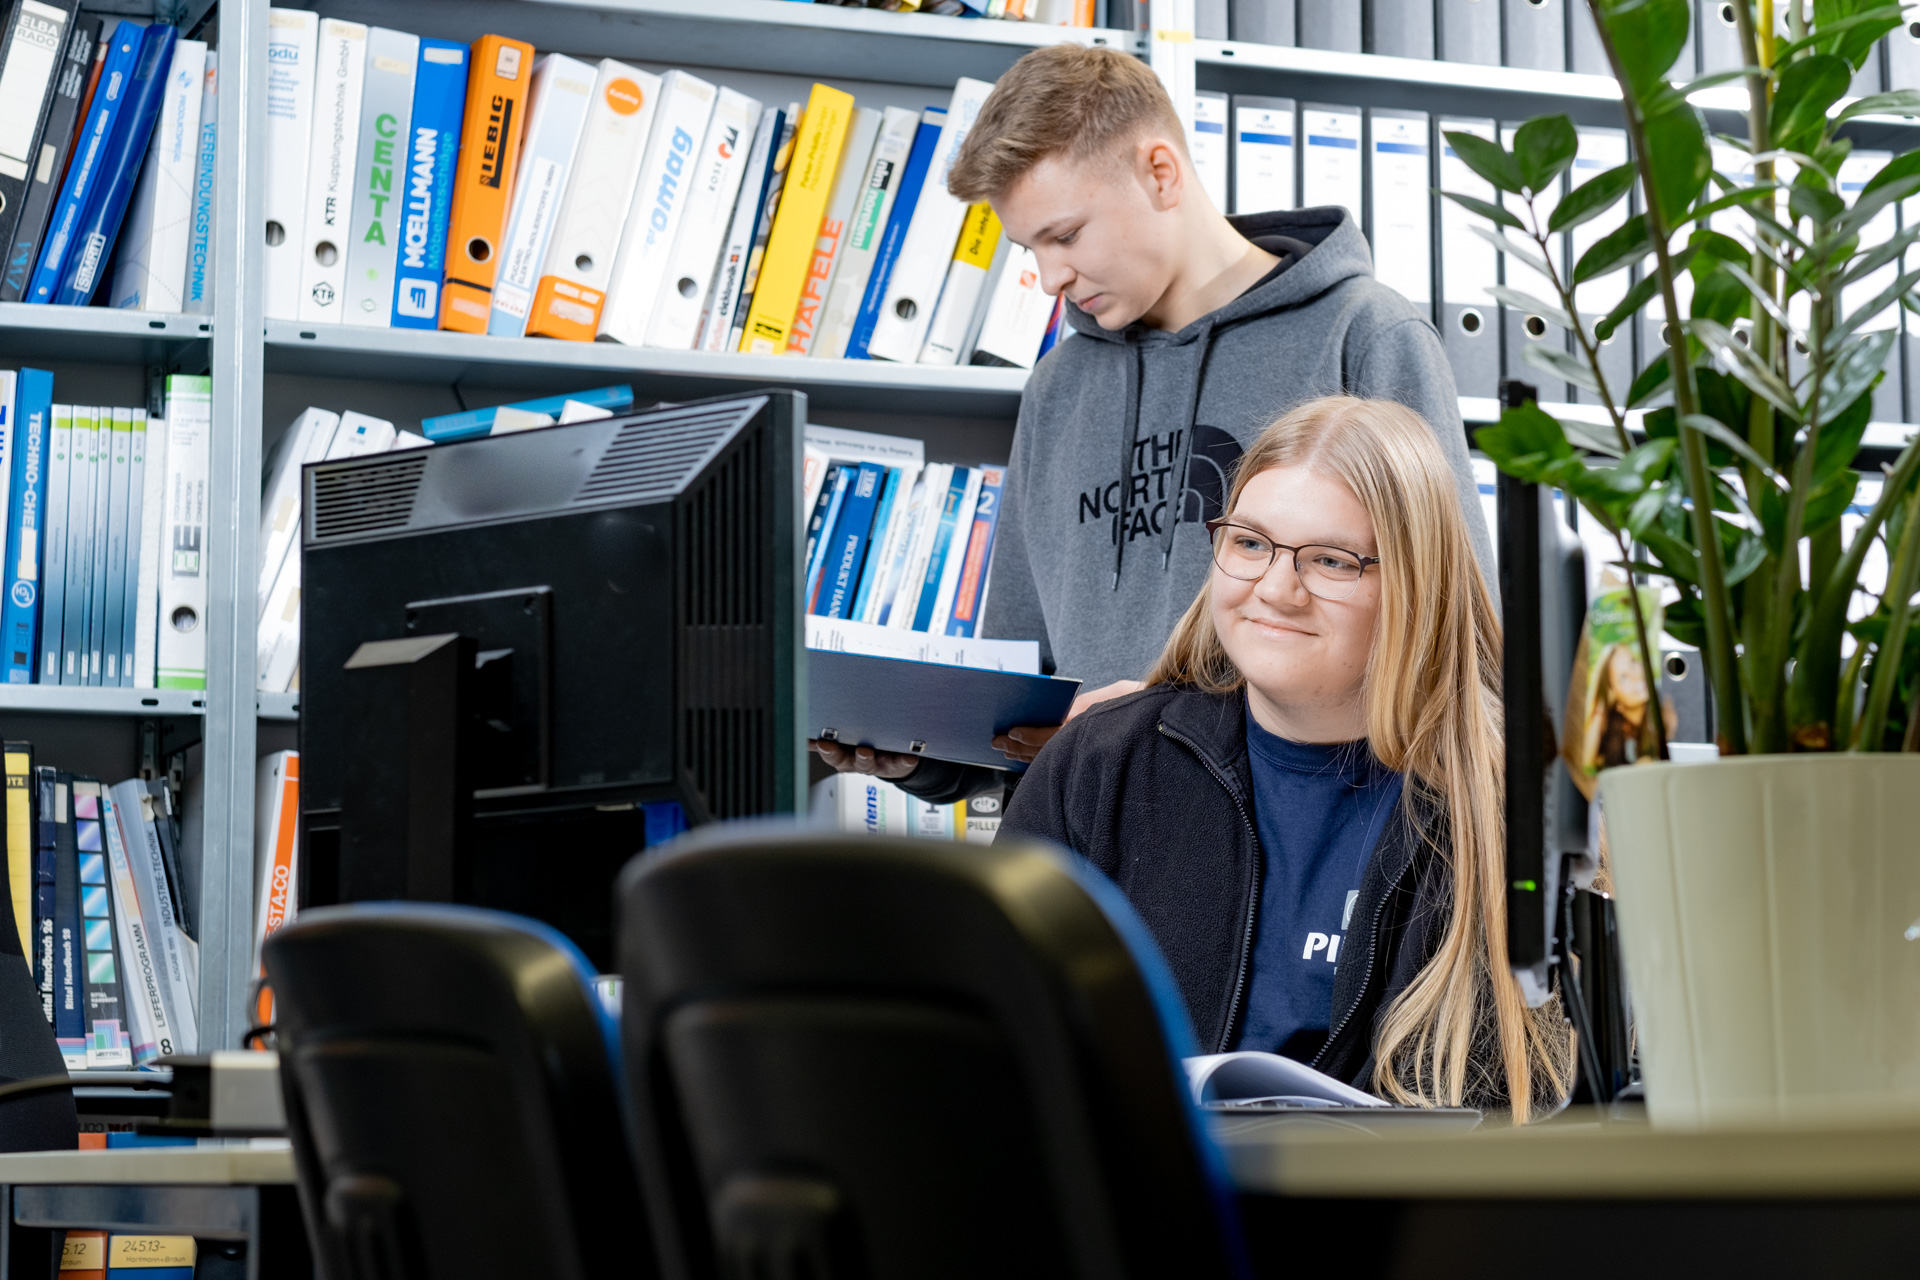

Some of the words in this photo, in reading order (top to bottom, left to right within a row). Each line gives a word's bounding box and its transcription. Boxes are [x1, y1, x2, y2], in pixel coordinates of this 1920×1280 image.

[16, 27, 56, 48] RADO
[19, 14, 60, 38] ELBA
[337, 39, 350, 77] GmbH
[328, 79, 347, 193] Kupplungstechnik
[363, 113, 398, 247] CENTA
[191, 122, 216, 301] VERBINDUNGSTECHNIK
[325, 197, 337, 226] KTR
[76, 236, 104, 290] SIMRIT
[785, 215, 843, 354] HÄFELE
[977, 491, 996, 515] 2
[1079, 466, 1183, 524] NORT
[1112, 500, 1181, 546] FAC
[966, 820, 1000, 832] PILLE
[148, 830, 173, 928] INDUSTRIE-TECHNIK
[40, 936, 53, 993] Handbuch
[63, 941, 73, 985] Handbuch
[132, 923, 167, 1028] LIEFERPROGRAMM
[64, 985, 74, 1010] Rittal
[160, 1038, 173, 1056] 8
